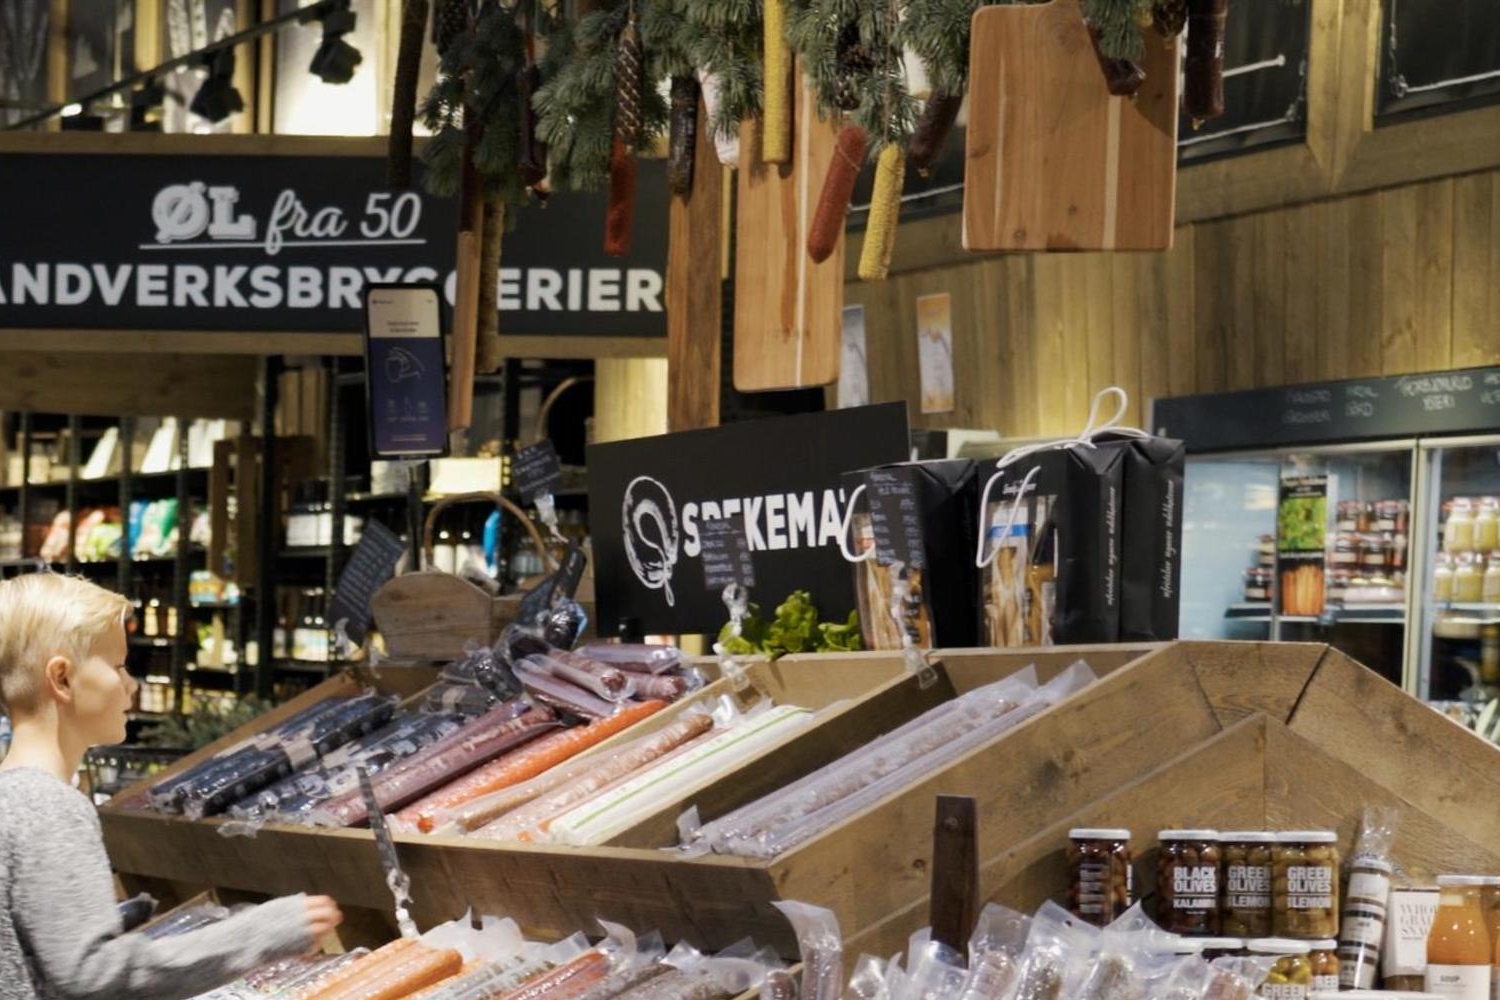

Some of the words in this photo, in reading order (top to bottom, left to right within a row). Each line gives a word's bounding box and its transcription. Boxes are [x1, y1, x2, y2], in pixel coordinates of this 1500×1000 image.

[152, 181, 257, 244] ØL
[265, 189, 349, 255] fra
[359, 192, 422, 238] 50
[682, 488, 846, 558] SKEMA
[1173, 866, 1216, 880] BLACK
[1228, 866, 1270, 879] GREEN
[1287, 866, 1332, 880] GREEN
[1173, 880, 1217, 893] OLIVES
[1228, 880, 1270, 892] OLIVES
[1287, 880, 1332, 892] OLIVES
[1263, 984, 1307, 997] GREEN
